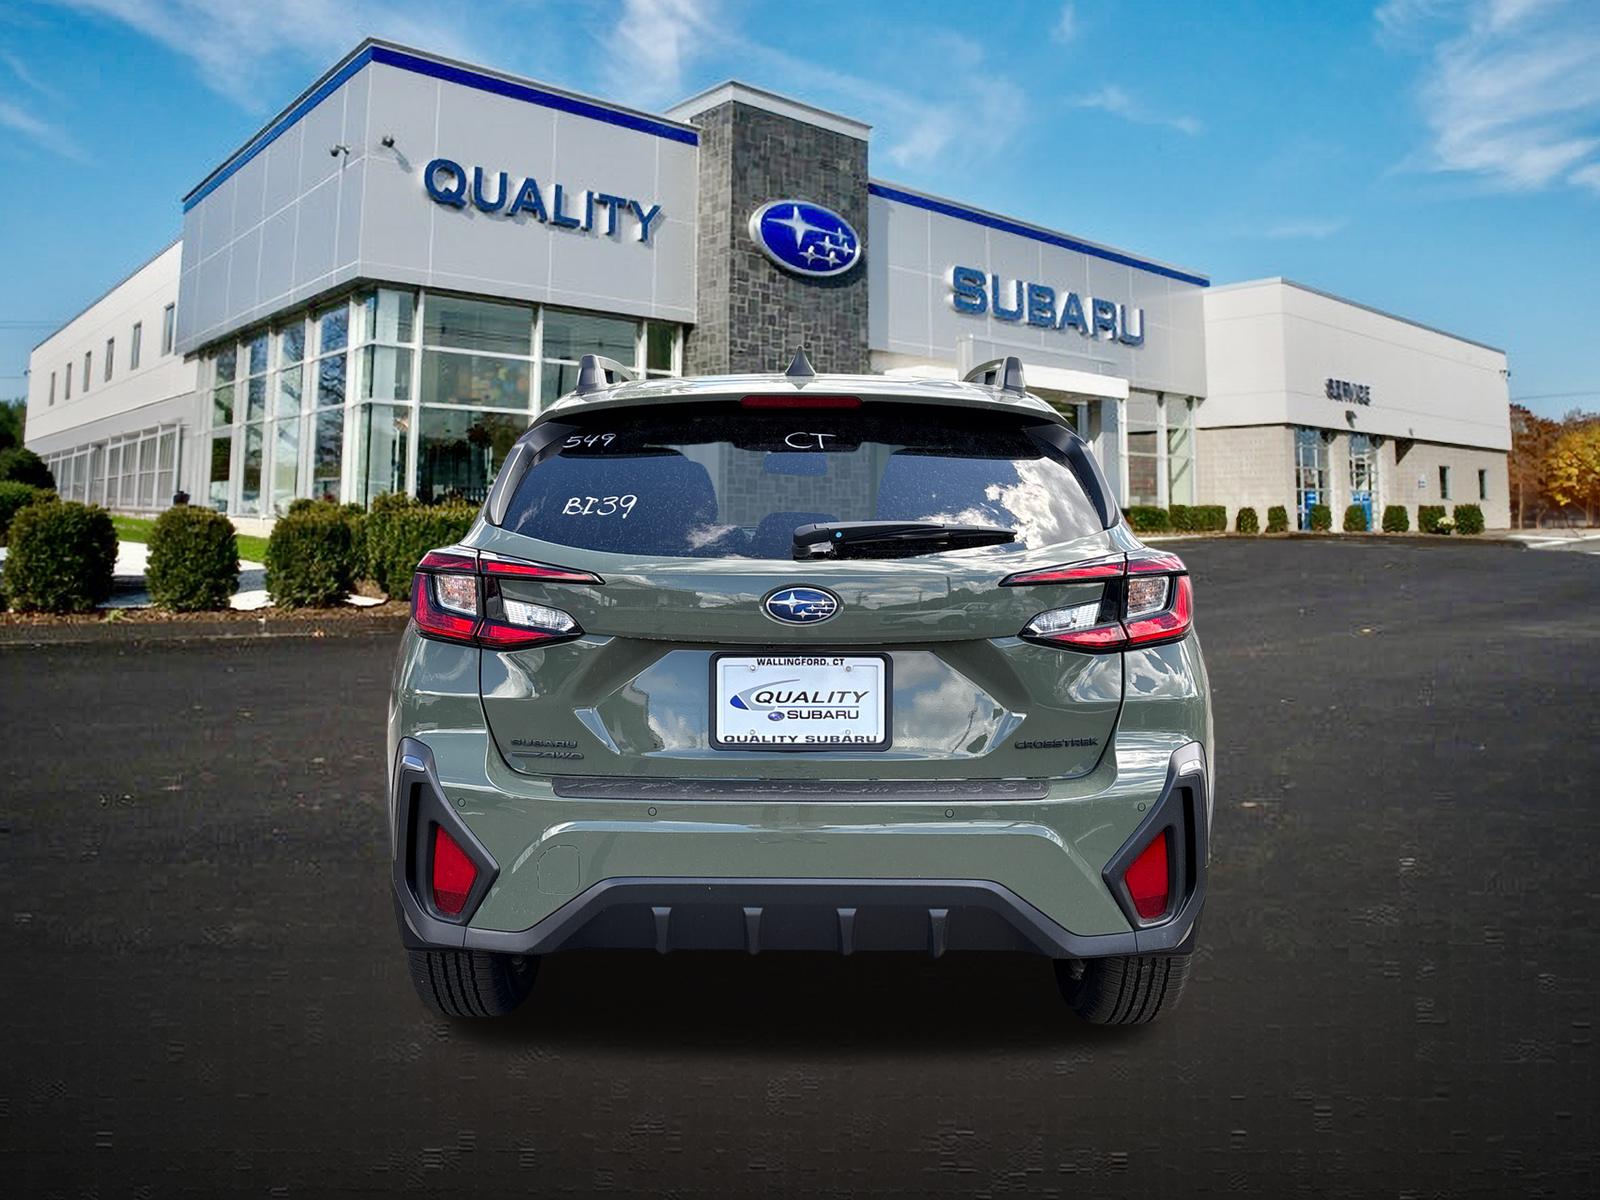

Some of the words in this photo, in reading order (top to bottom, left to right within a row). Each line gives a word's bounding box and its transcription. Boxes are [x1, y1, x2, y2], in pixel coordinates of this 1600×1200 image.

[424, 158, 661, 243] QUALITY
[951, 265, 1146, 347] SUBARU
[562, 433, 617, 449] 549
[784, 431, 837, 449] CT
[832, 658, 845, 666] CT
[755, 691, 870, 704] QUALITY
[786, 710, 860, 720] SUBARU
[511, 738, 578, 749] SUBARU
[723, 735, 799, 744] QUALITY
[805, 735, 878, 744] SUBARU
[1014, 738, 1098, 750] CROSSTREK
[537, 751, 584, 760] AWD
